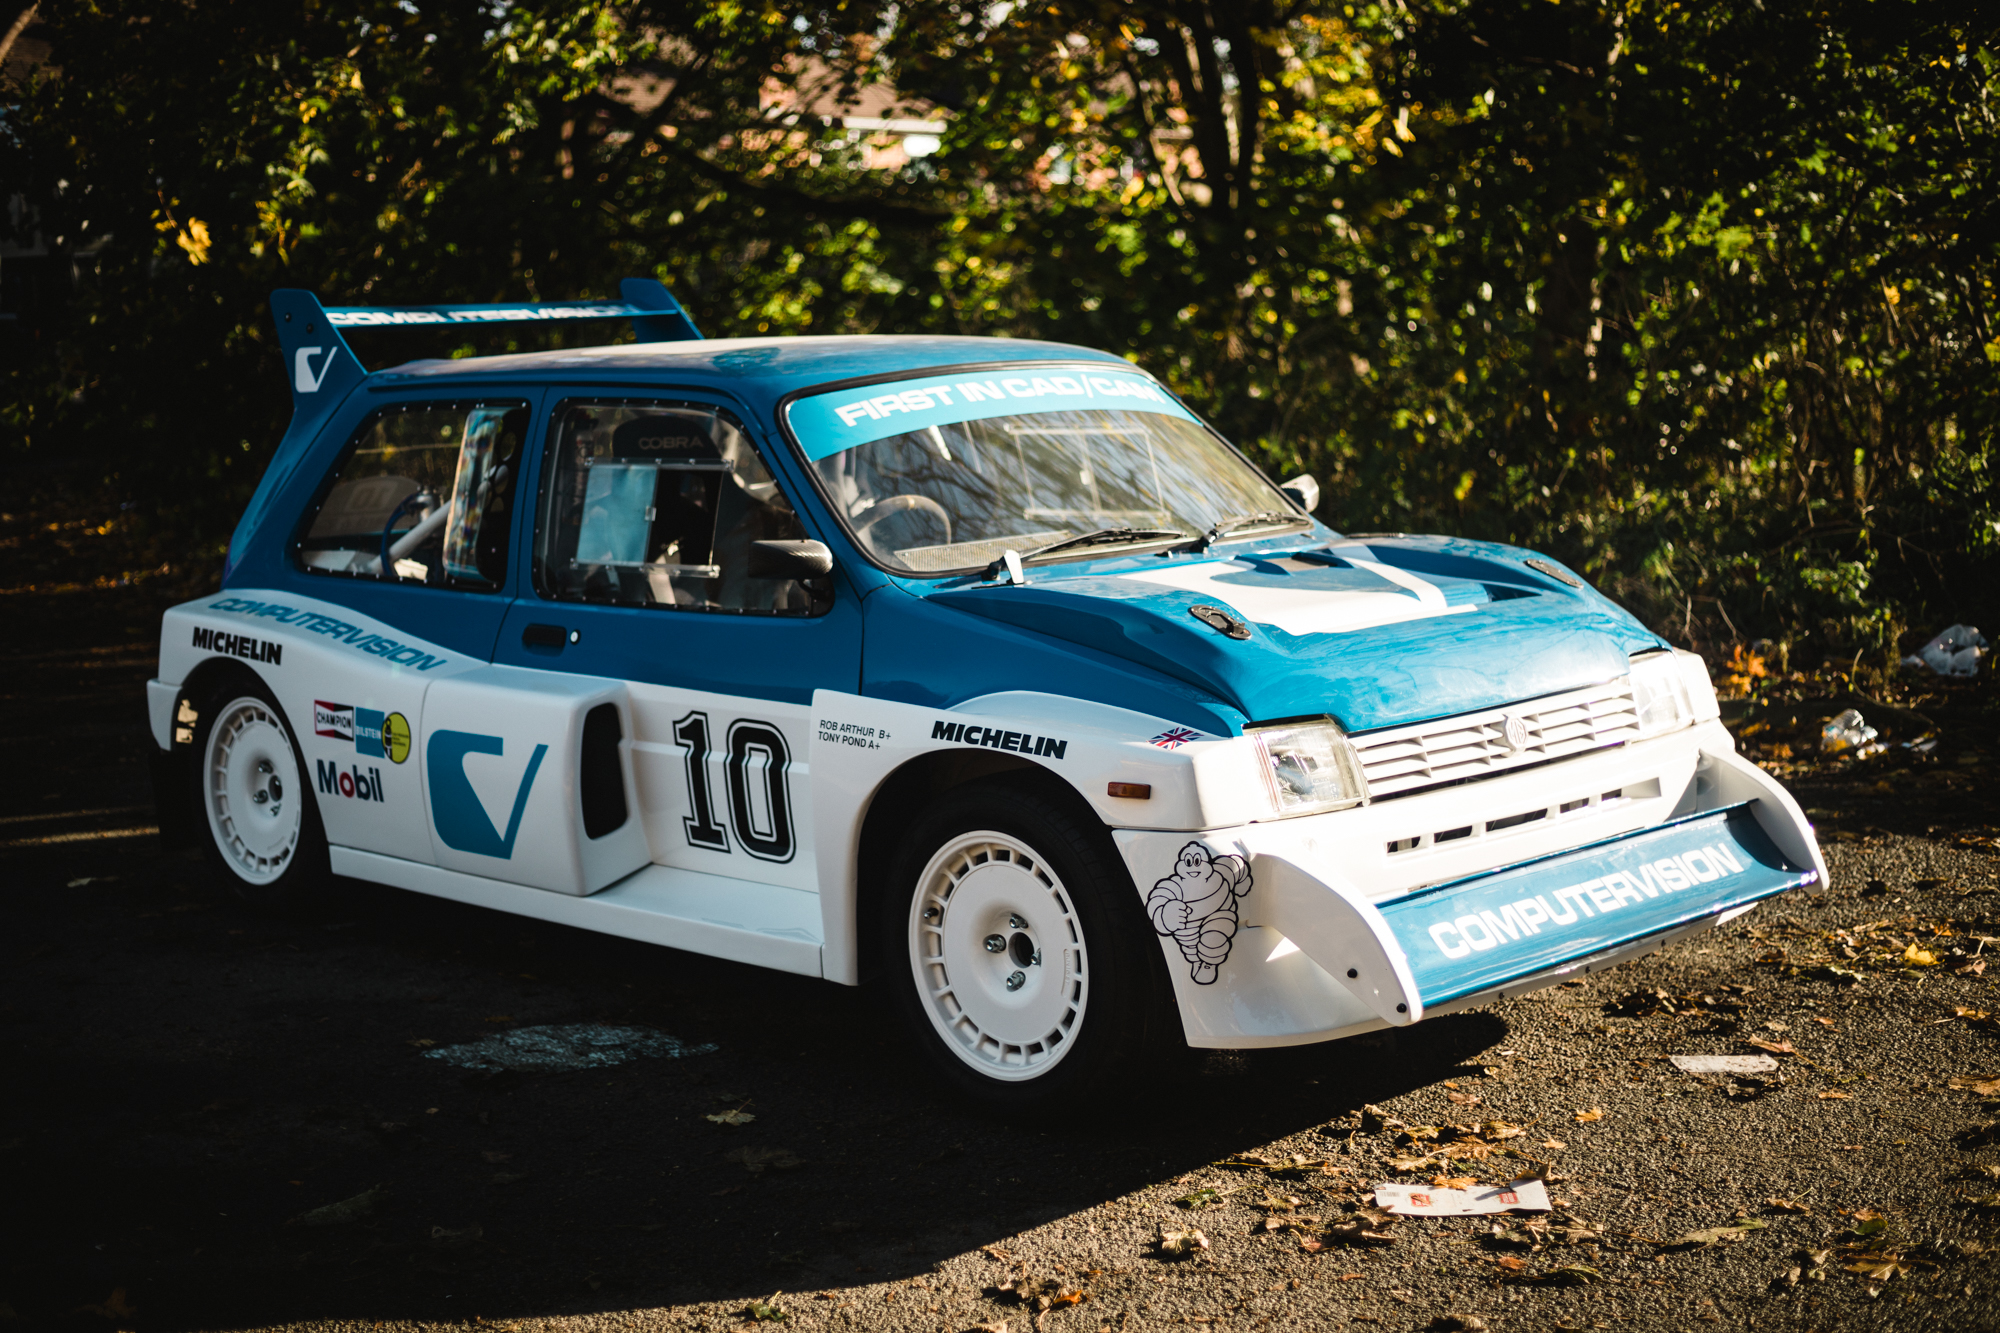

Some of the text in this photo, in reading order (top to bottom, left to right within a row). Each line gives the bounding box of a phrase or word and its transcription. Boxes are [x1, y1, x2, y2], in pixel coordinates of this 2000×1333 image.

[834, 373, 1167, 427] FIRST IN CAD/CAM
[638, 436, 704, 450] COBRA
[192, 626, 283, 666] MICHELIN
[208, 598, 448, 672] COMPUTERVISION
[317, 712, 351, 728] CHAMPION
[356, 726, 381, 739] BILSTEIN
[818, 730, 881, 750] TONY POND A+
[819, 720, 891, 740] ROB ARTHUR B+
[931, 720, 1068, 760] MICHELIN
[316, 758, 385, 803] Mobil
[672, 710, 797, 865] 10
[1427, 842, 1745, 960] COMPUTERVISION
